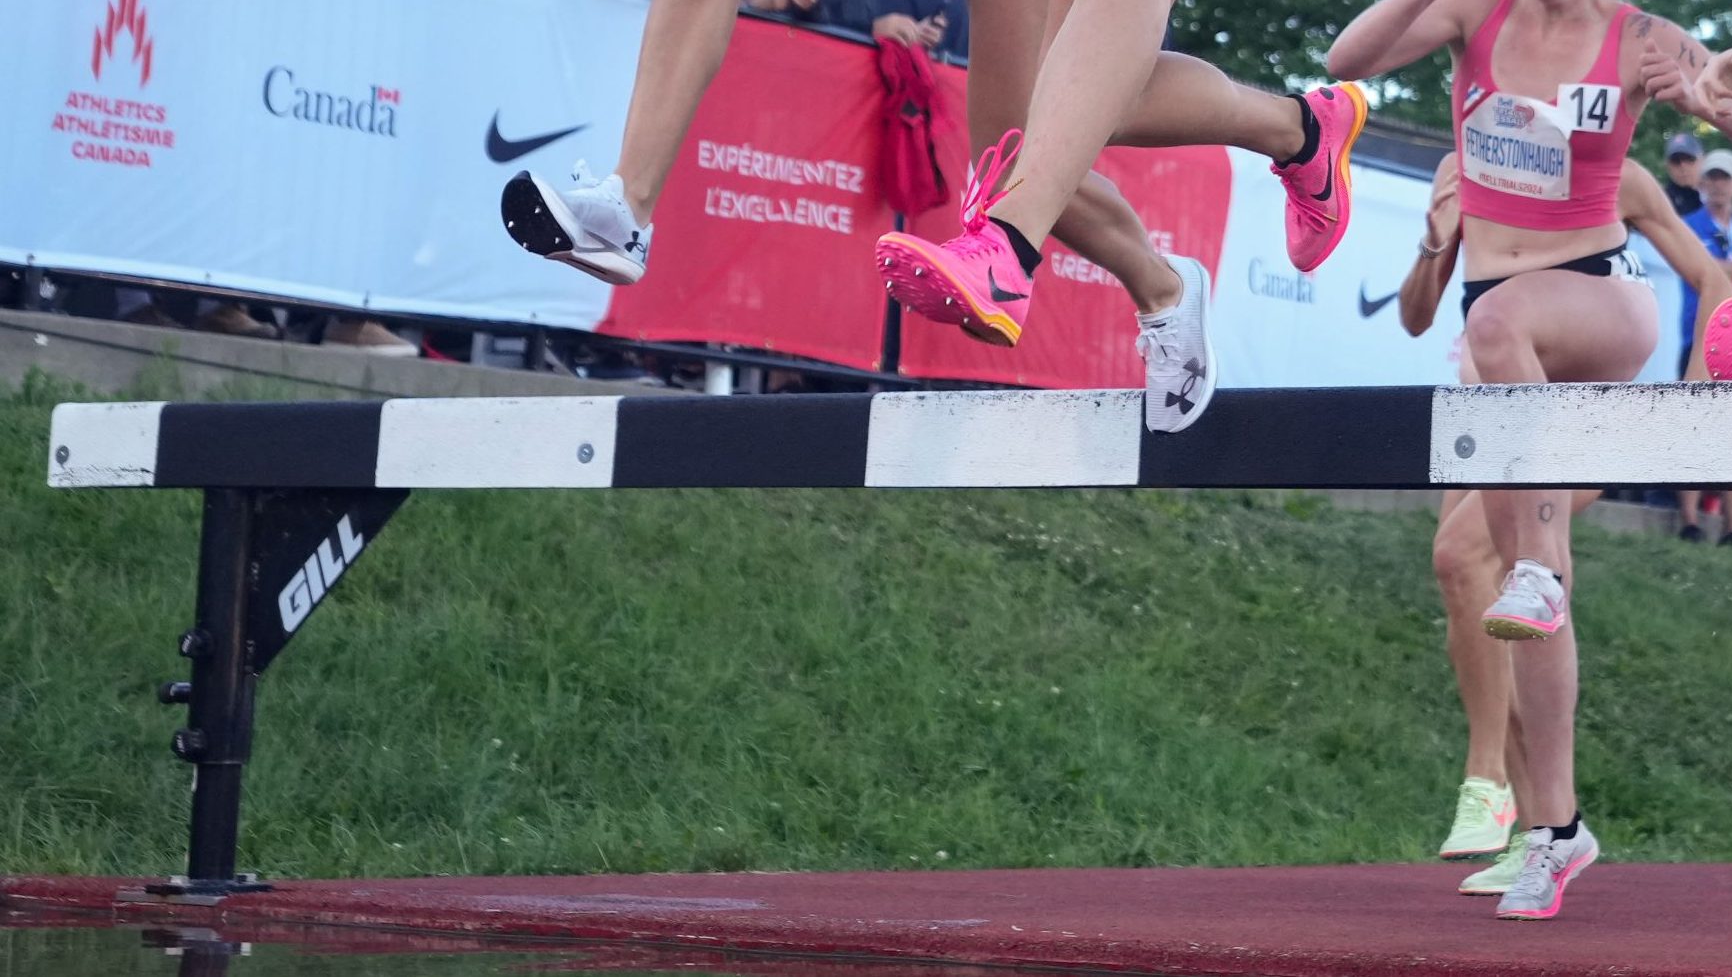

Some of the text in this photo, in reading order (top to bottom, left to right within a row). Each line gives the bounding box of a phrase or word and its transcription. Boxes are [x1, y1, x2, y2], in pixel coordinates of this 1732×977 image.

[66, 90, 167, 124] ATHLETICS
[262, 64, 398, 139] Canada
[1570, 87, 1609, 131] 14
[71, 140, 151, 168] CANADA
[698, 139, 868, 194] EXPÉRIMENTEZ
[1465, 126, 1566, 178] FETHERSTONHAUGH
[1248, 257, 1314, 304] Canada
[277, 514, 364, 633] GILL
